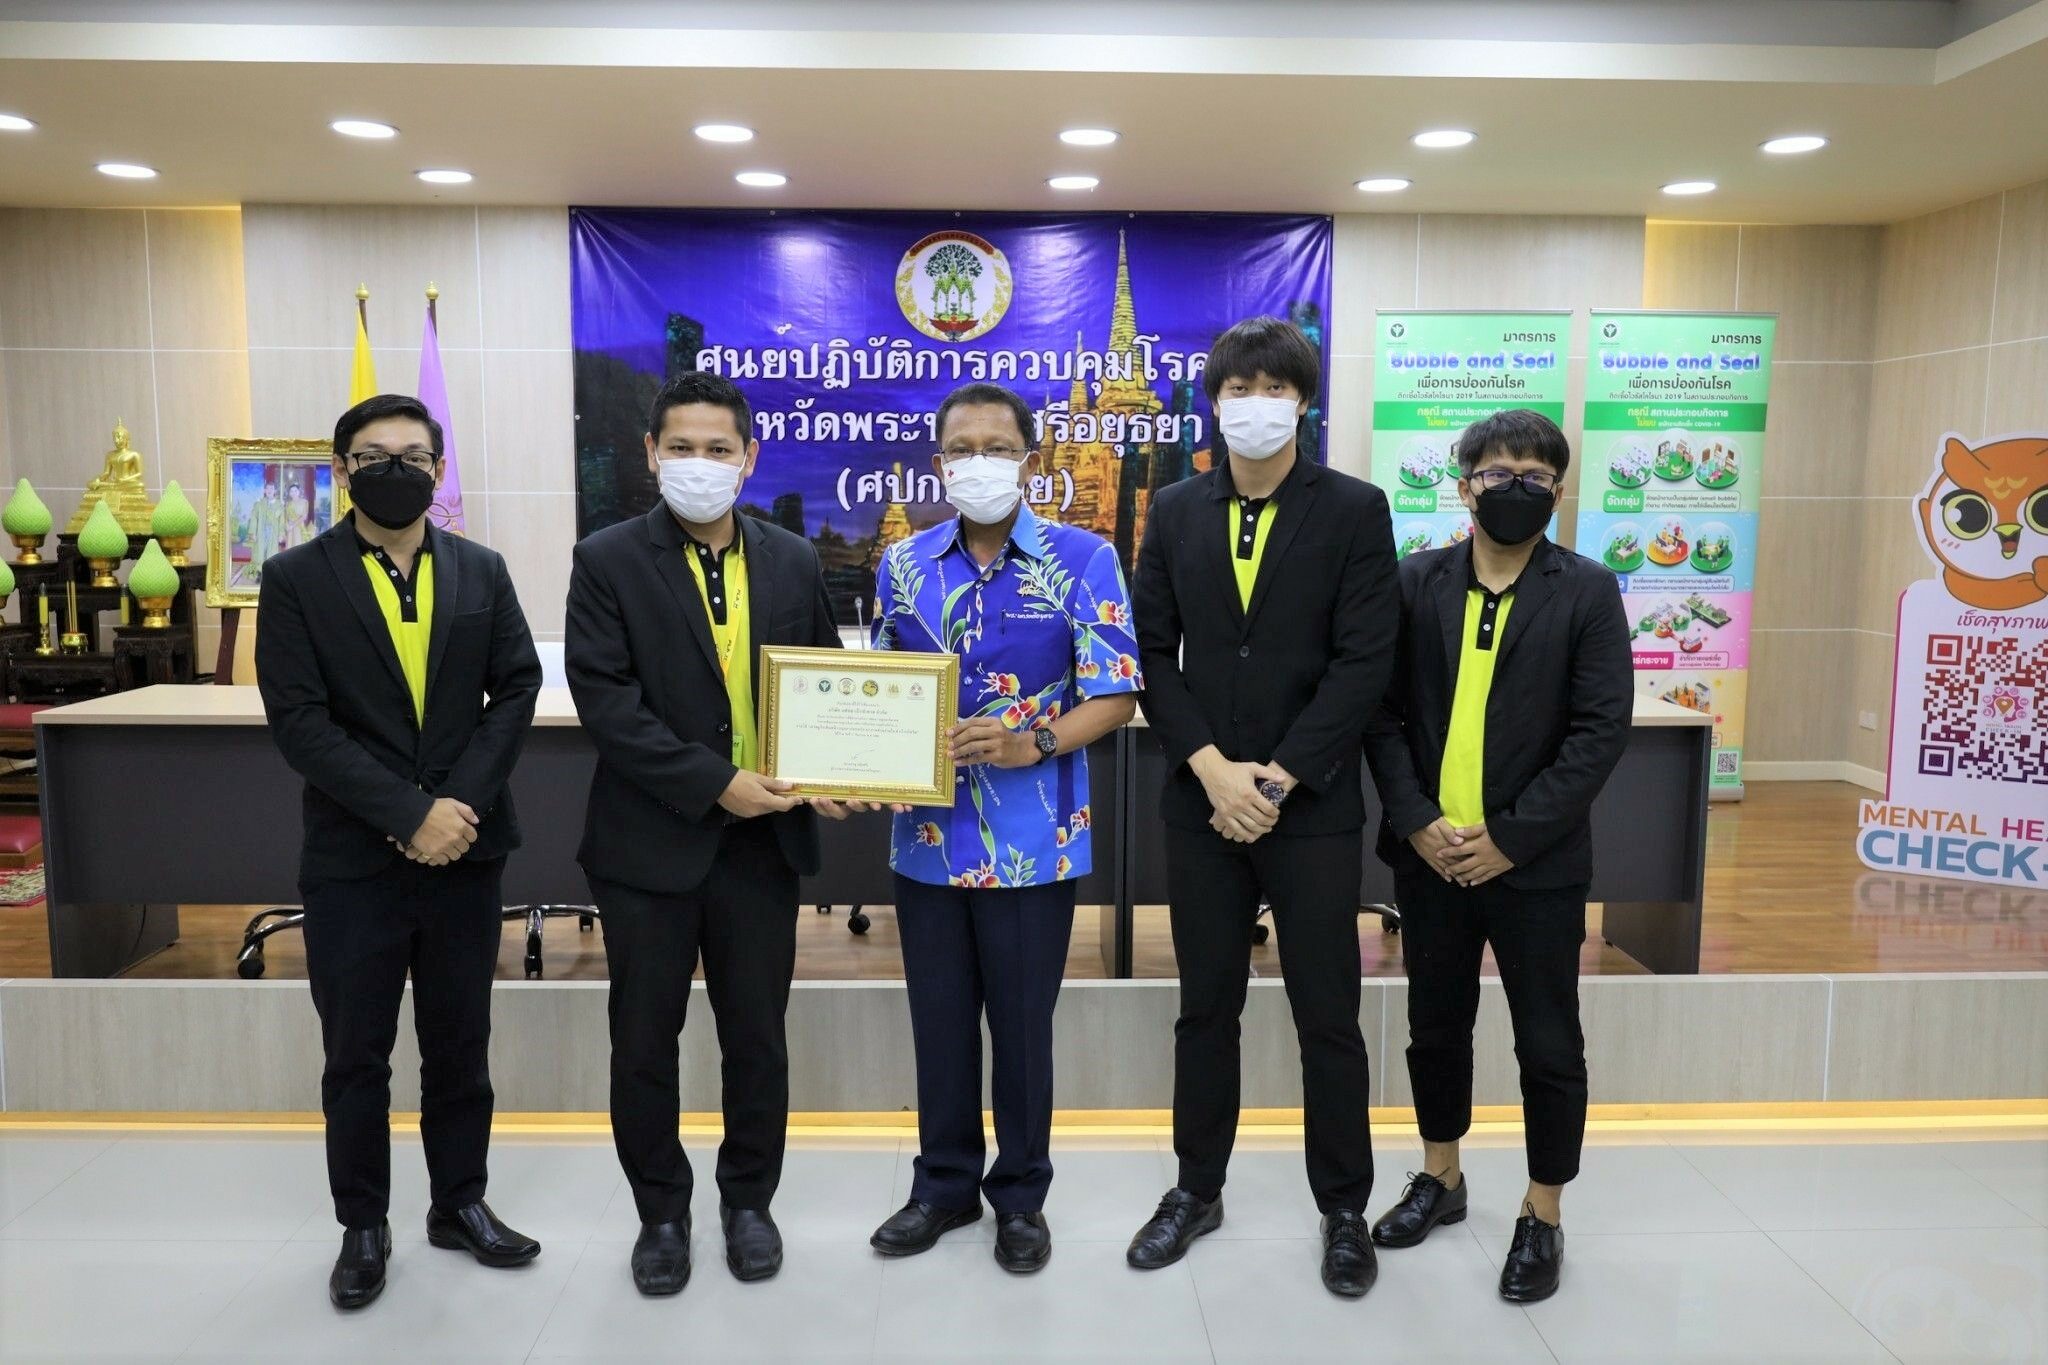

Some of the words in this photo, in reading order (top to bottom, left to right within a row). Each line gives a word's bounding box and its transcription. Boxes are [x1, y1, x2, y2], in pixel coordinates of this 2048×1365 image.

[1503, 331, 1556, 343] มาตรการ
[1711, 333, 1762, 345] มาตรการ
[696, 323, 1209, 396] ศนย์ปฏิบัติการควบคุมโรค
[1466, 353, 1504, 369] and
[1512, 352, 1555, 369] Seal
[1602, 352, 1669, 369] Bubble
[1676, 353, 1712, 370] and
[1719, 353, 1760, 370] Seal
[1417, 371, 1525, 389] เพื่อการป้องกันโรค
[1628, 372, 1732, 390] เพื่อการป้องกันโรค
[1863, 803, 1987, 836] MENTAL
[2001, 817, 2048, 842] HE
